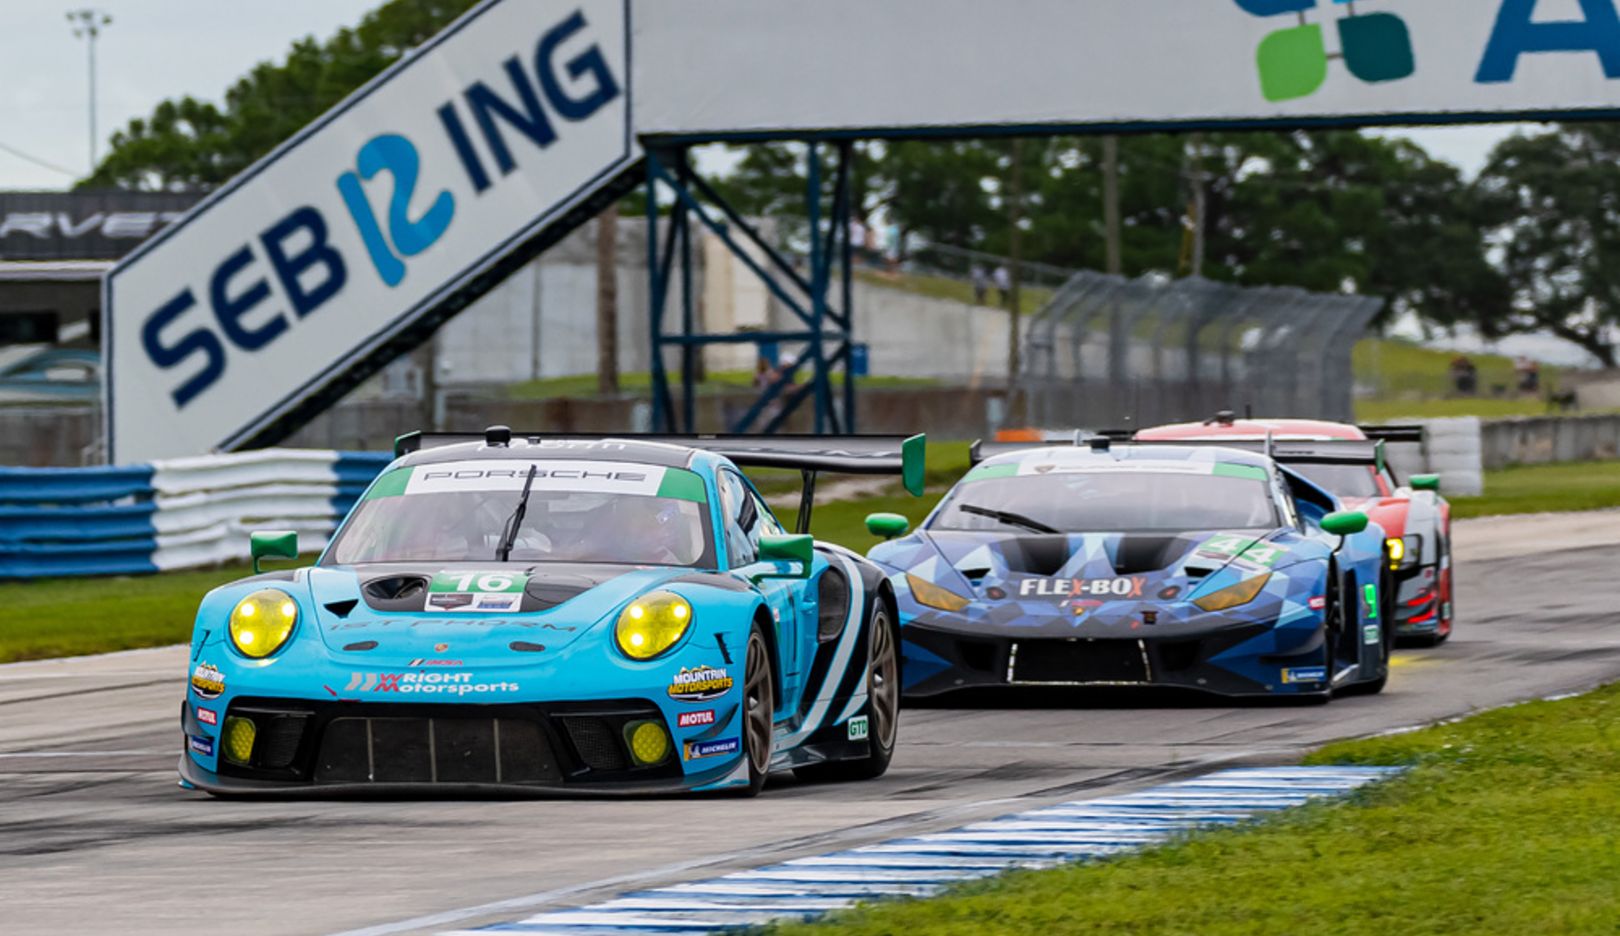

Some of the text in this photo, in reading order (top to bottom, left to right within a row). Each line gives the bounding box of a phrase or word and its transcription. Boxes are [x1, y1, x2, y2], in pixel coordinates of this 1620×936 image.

[424, 469, 648, 481] PORSCHE
[450, 573, 513, 592] 16
[1019, 576, 1146, 598] FLEX-BOX
[373, 682, 520, 696] Motorsports
[679, 712, 714, 727] MOTUL
[850, 720, 867, 736] GTD
[702, 742, 737, 754] MICHELIN
